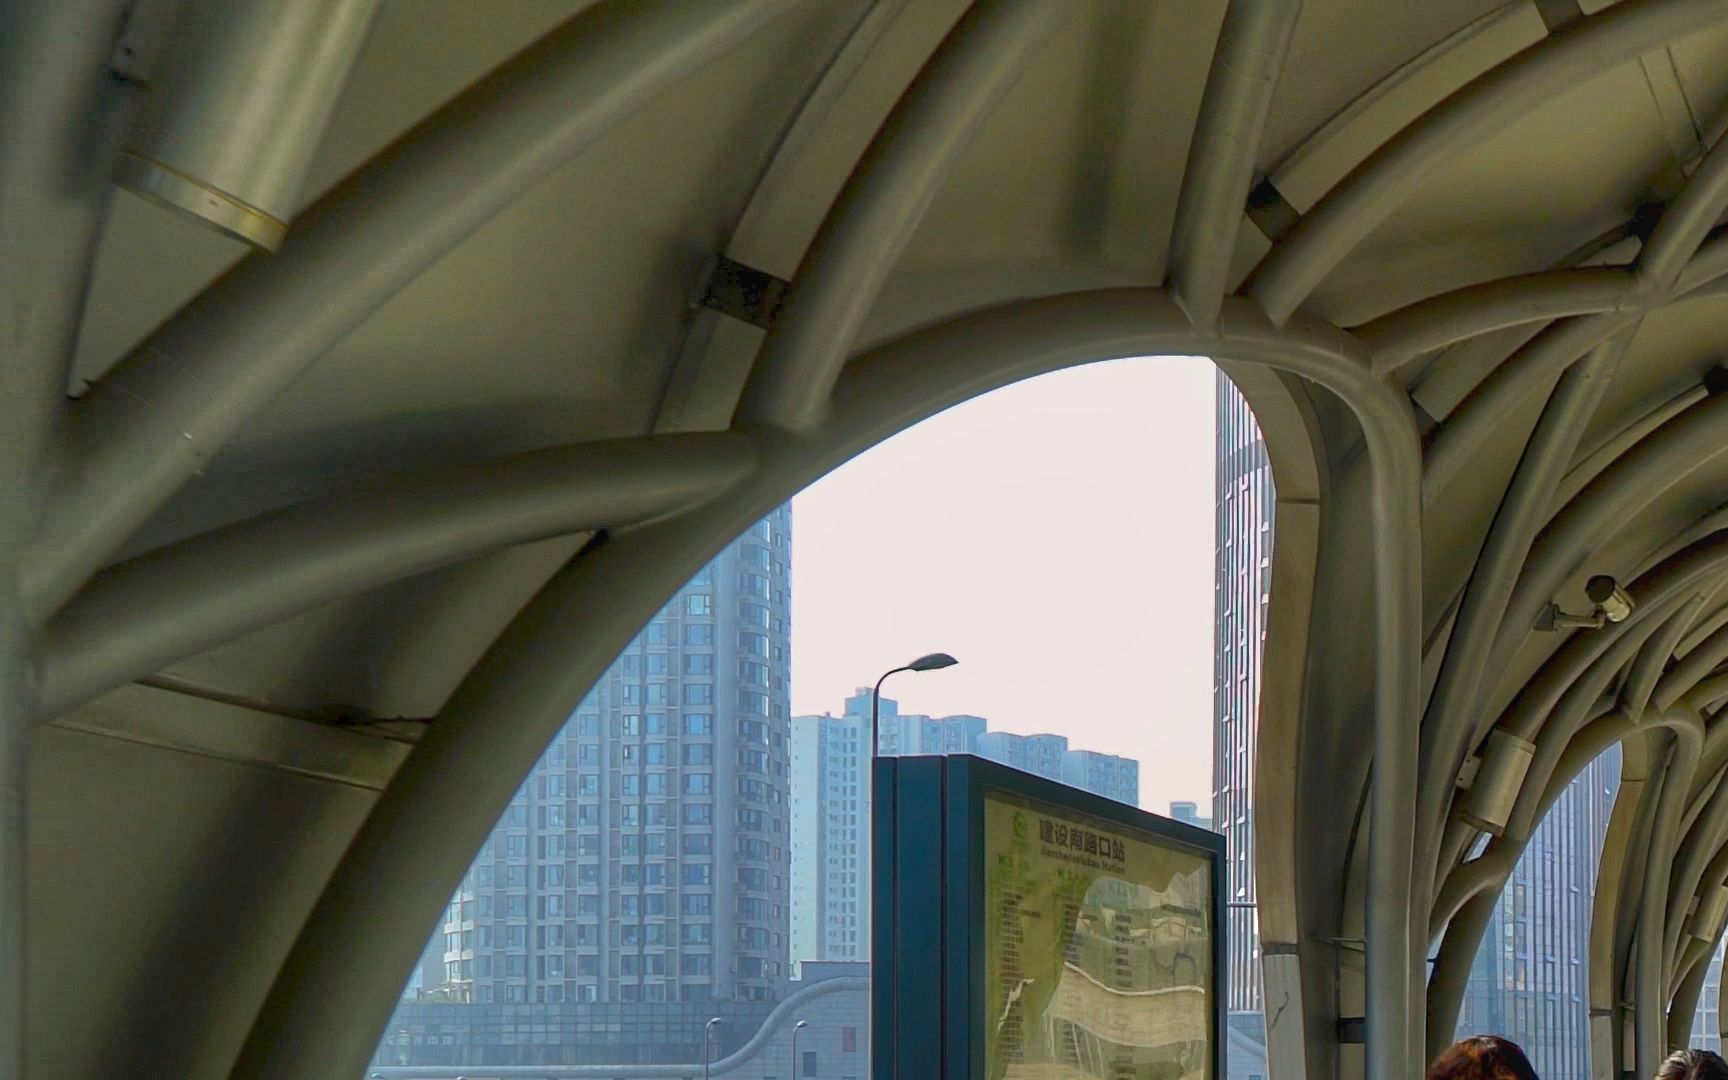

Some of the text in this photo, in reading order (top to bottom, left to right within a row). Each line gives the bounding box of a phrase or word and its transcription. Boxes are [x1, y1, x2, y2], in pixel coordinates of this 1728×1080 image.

[1039, 819, 1126, 862] 建设南路口站
